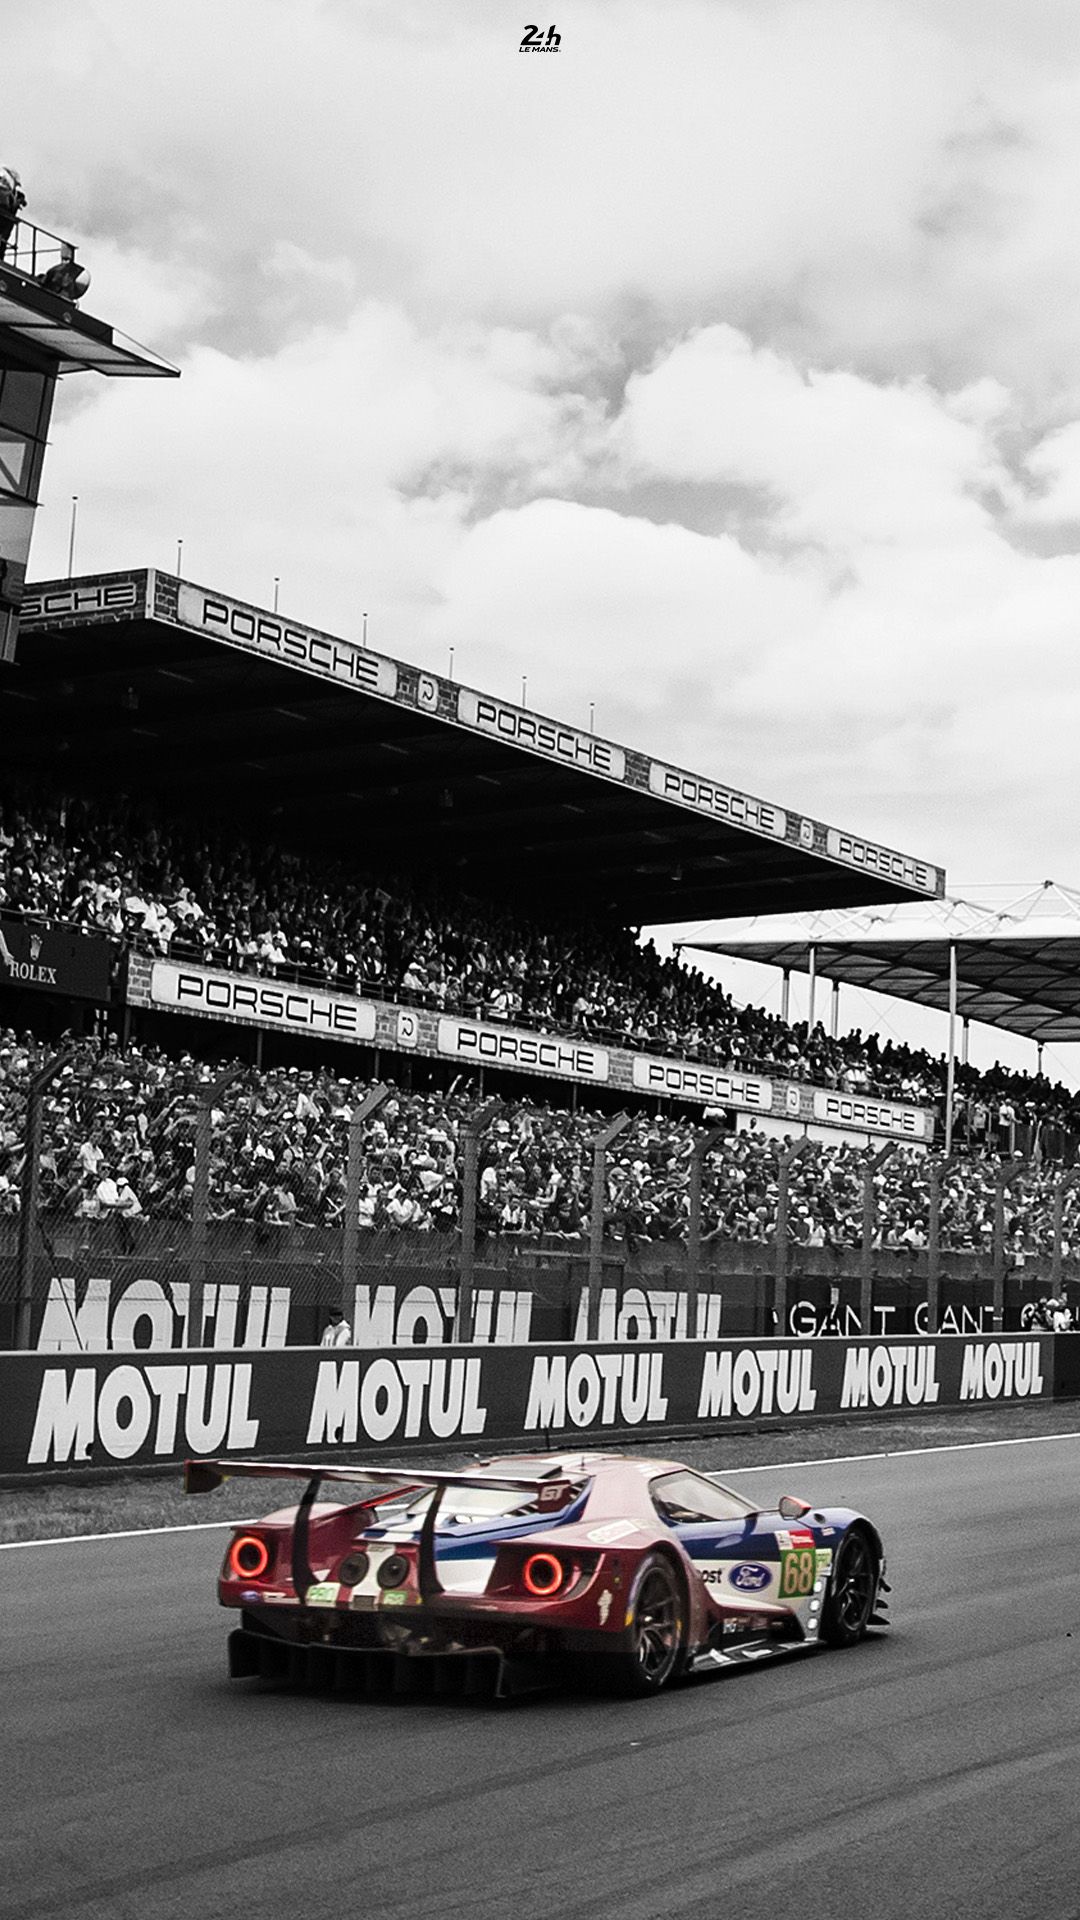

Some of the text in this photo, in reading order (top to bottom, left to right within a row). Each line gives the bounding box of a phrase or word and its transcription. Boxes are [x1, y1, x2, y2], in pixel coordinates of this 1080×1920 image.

[19, 584, 135, 616] SCHE
[202, 598, 379, 686] PORSCHE
[476, 700, 611, 771] PORSCHE
[664, 773, 775, 830] PORSCHE
[839, 838, 927, 887] PORSCHE
[9, 962, 57, 984] ROLEX
[177, 974, 357, 1032] PORSCHE
[457, 1027, 594, 1074] PORSCHE
[648, 1064, 760, 1103] PORSCHE
[826, 1098, 915, 1131] PORSCHE
[27, 1342, 1043, 1464] MOTUL MOTUL MOTUL MOTUL MOTUL MOTUL
[541, 1484, 571, 1501] GT
[736, 1566, 766, 1587] Ford
[784, 1551, 813, 1595] 68
